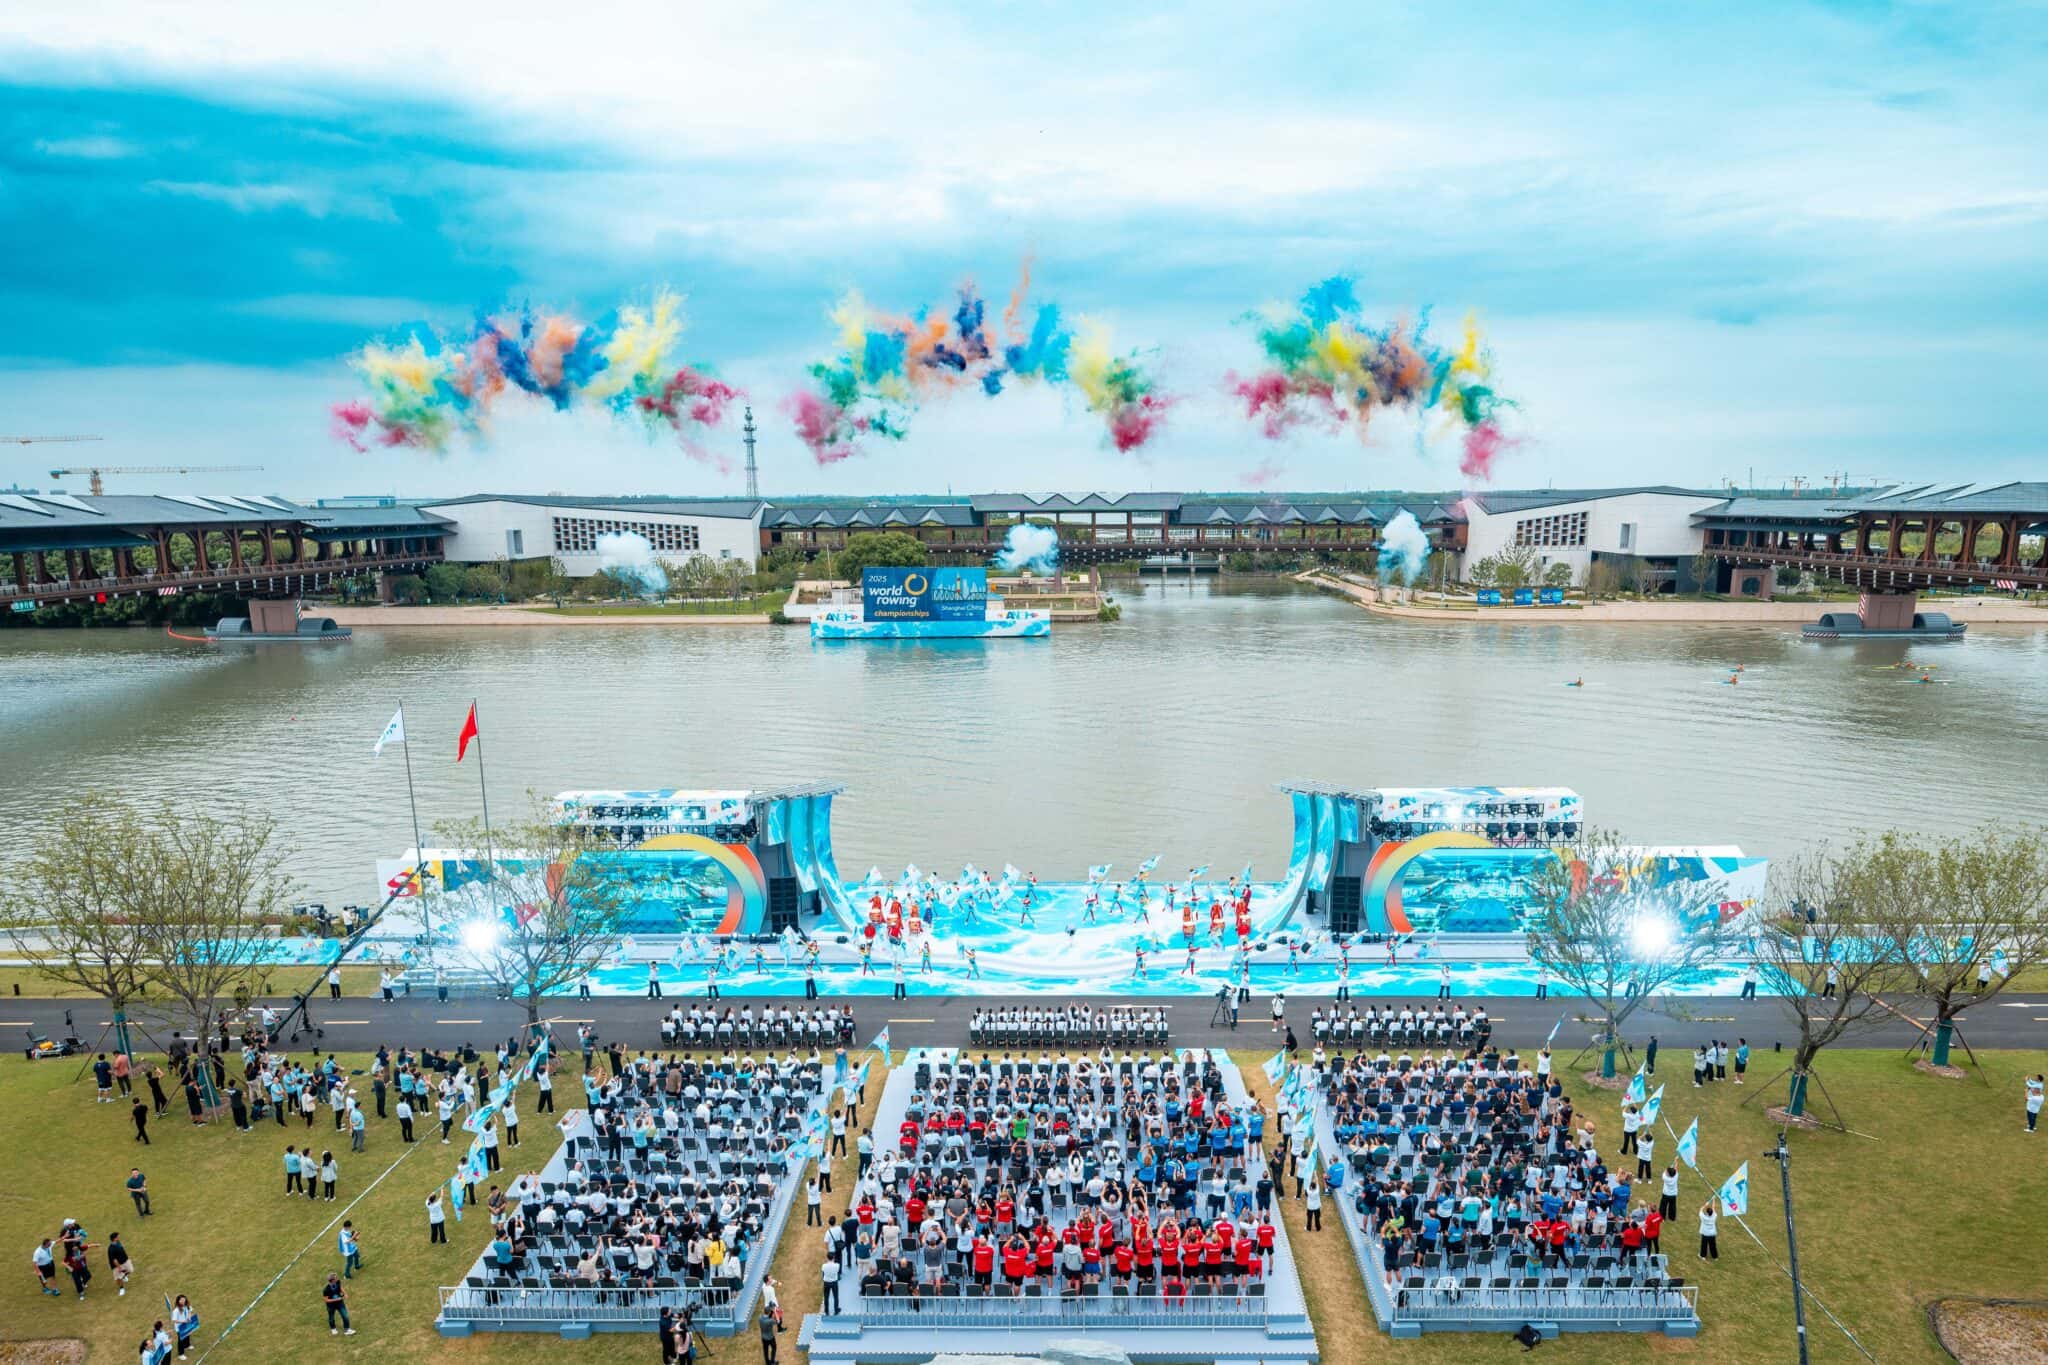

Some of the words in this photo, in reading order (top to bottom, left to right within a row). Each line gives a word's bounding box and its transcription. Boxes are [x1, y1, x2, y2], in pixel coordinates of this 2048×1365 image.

[868, 575, 887, 583] 2025
[869, 585, 903, 596] world
[876, 596, 917, 608] rowing
[874, 609, 930, 618] championships
